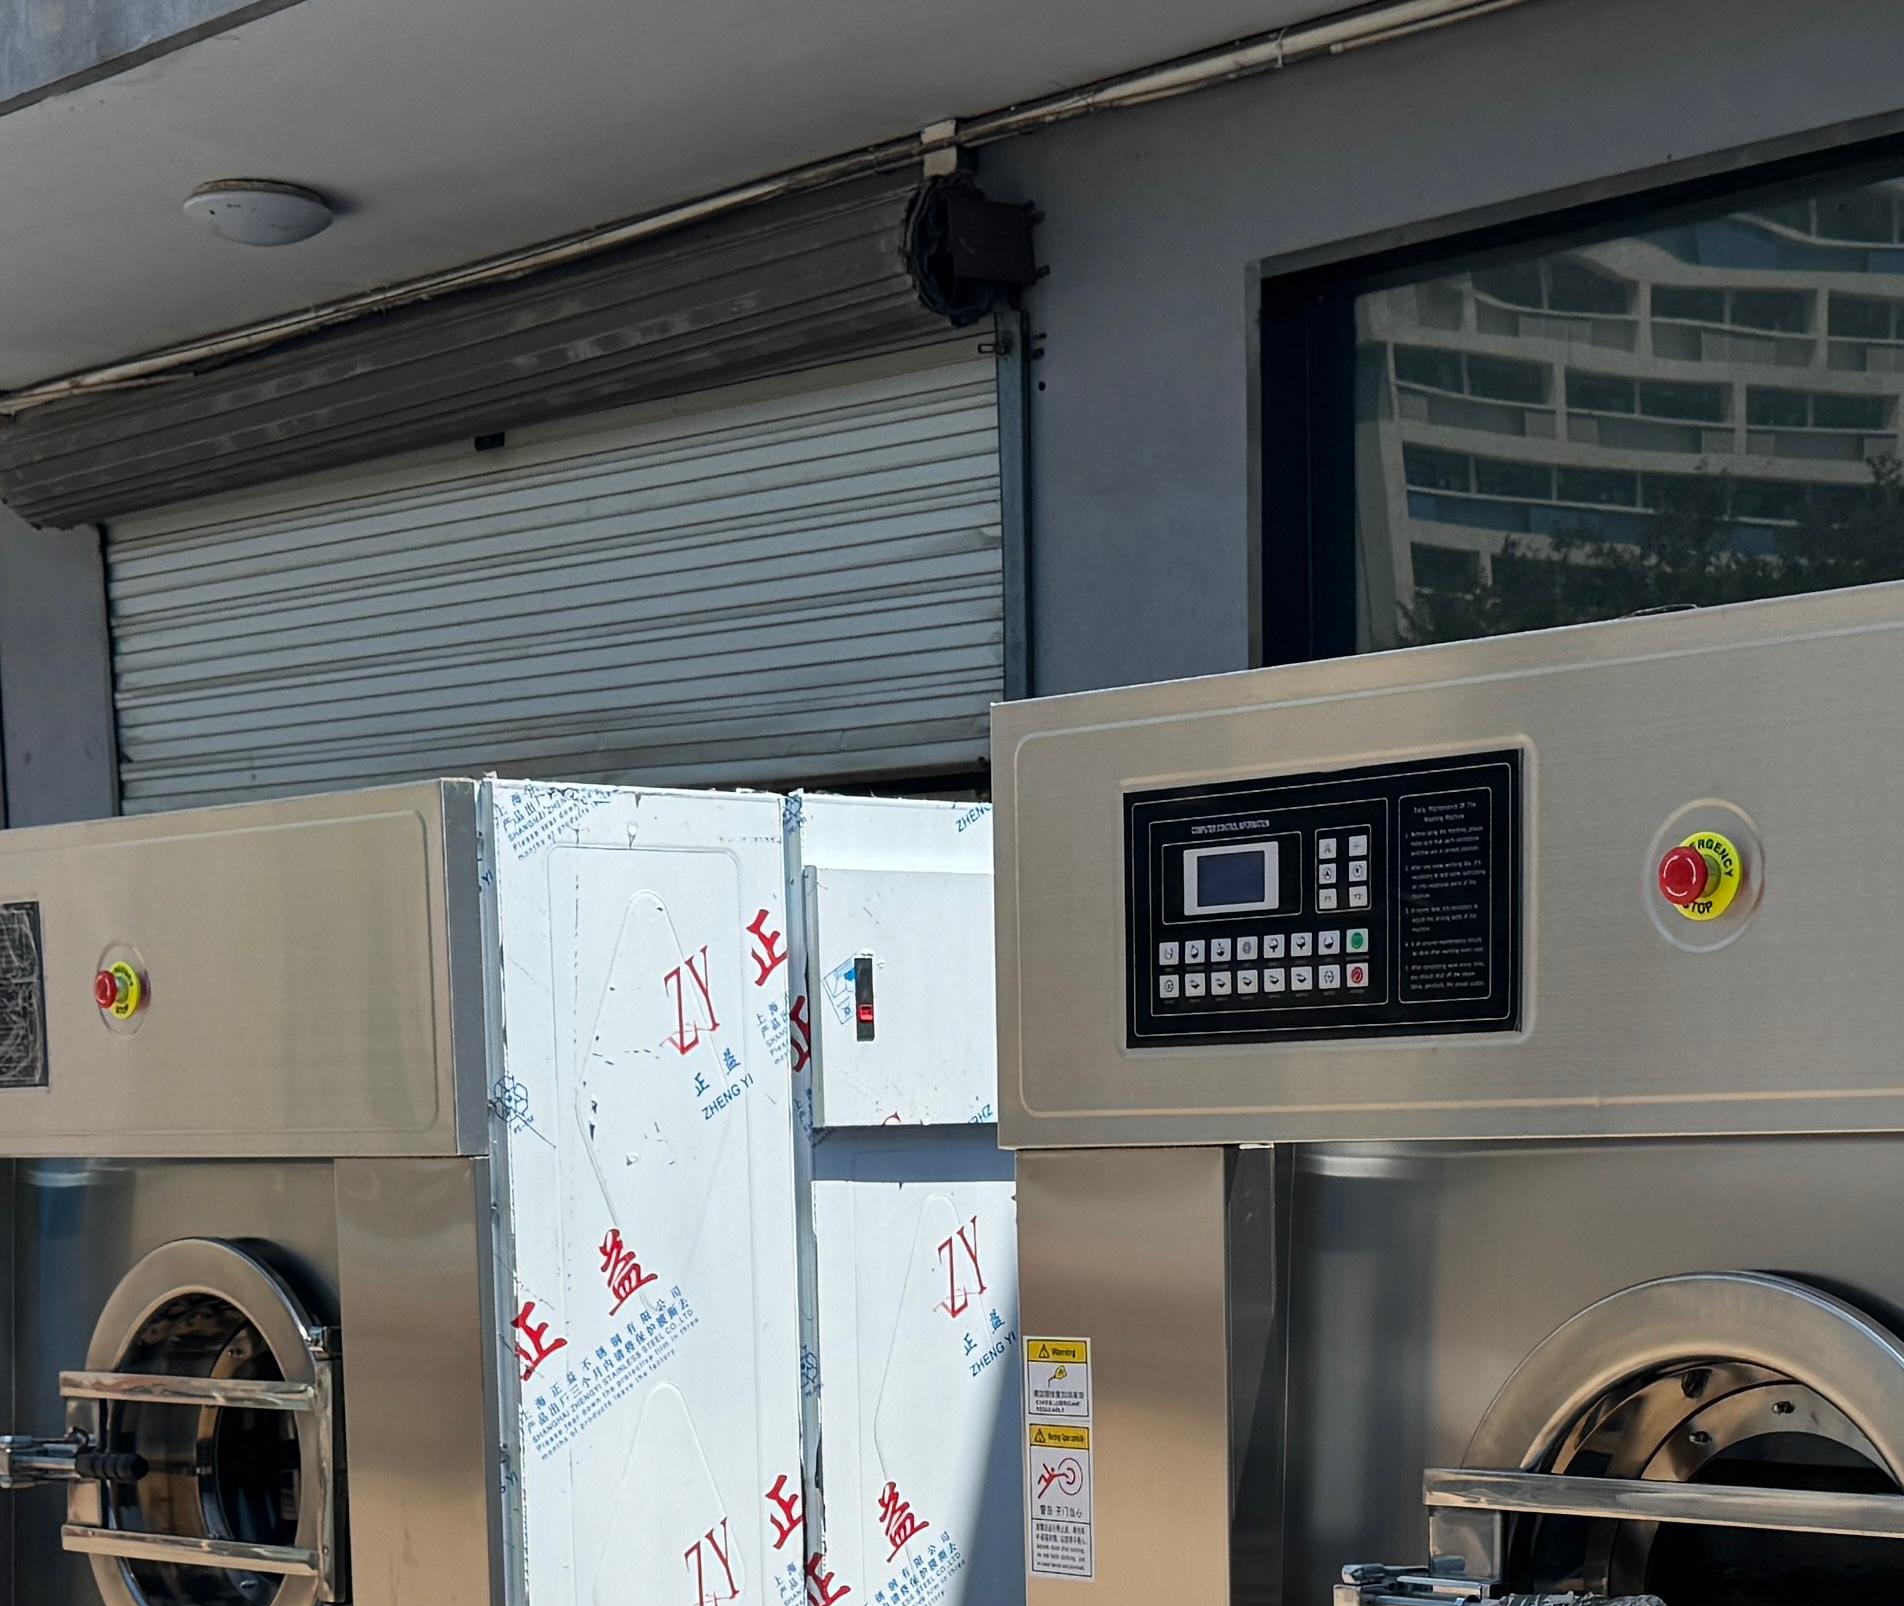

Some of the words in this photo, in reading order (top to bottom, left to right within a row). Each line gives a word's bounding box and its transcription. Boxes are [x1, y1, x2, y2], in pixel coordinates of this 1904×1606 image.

[660, 946, 721, 1056] ZY
[701, 1085, 741, 1121] ZHENG
[740, 1073, 755, 1094] YI
[932, 1215, 988, 1319] ZY
[969, 1343, 1005, 1377] ZHENG
[1003, 1331, 1017, 1352] YI
